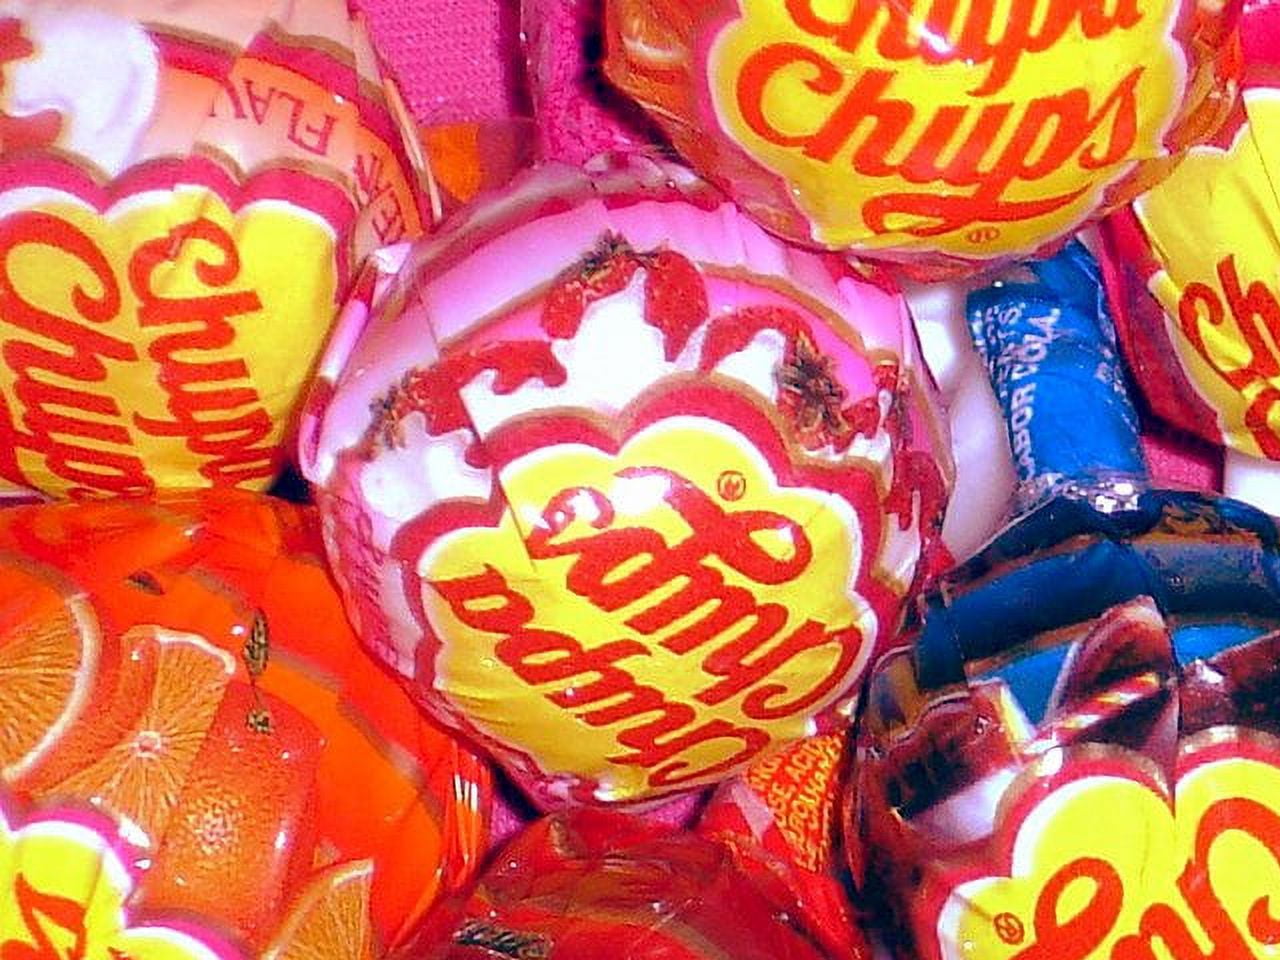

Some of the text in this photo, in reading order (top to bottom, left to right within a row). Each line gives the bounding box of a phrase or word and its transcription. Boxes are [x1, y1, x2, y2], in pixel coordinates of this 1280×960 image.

[735, 66, 1147, 237] Chups
[0, 210, 155, 499] Chup
[424, 562, 772, 788] Chupa
[525, 464, 862, 718] Chups
